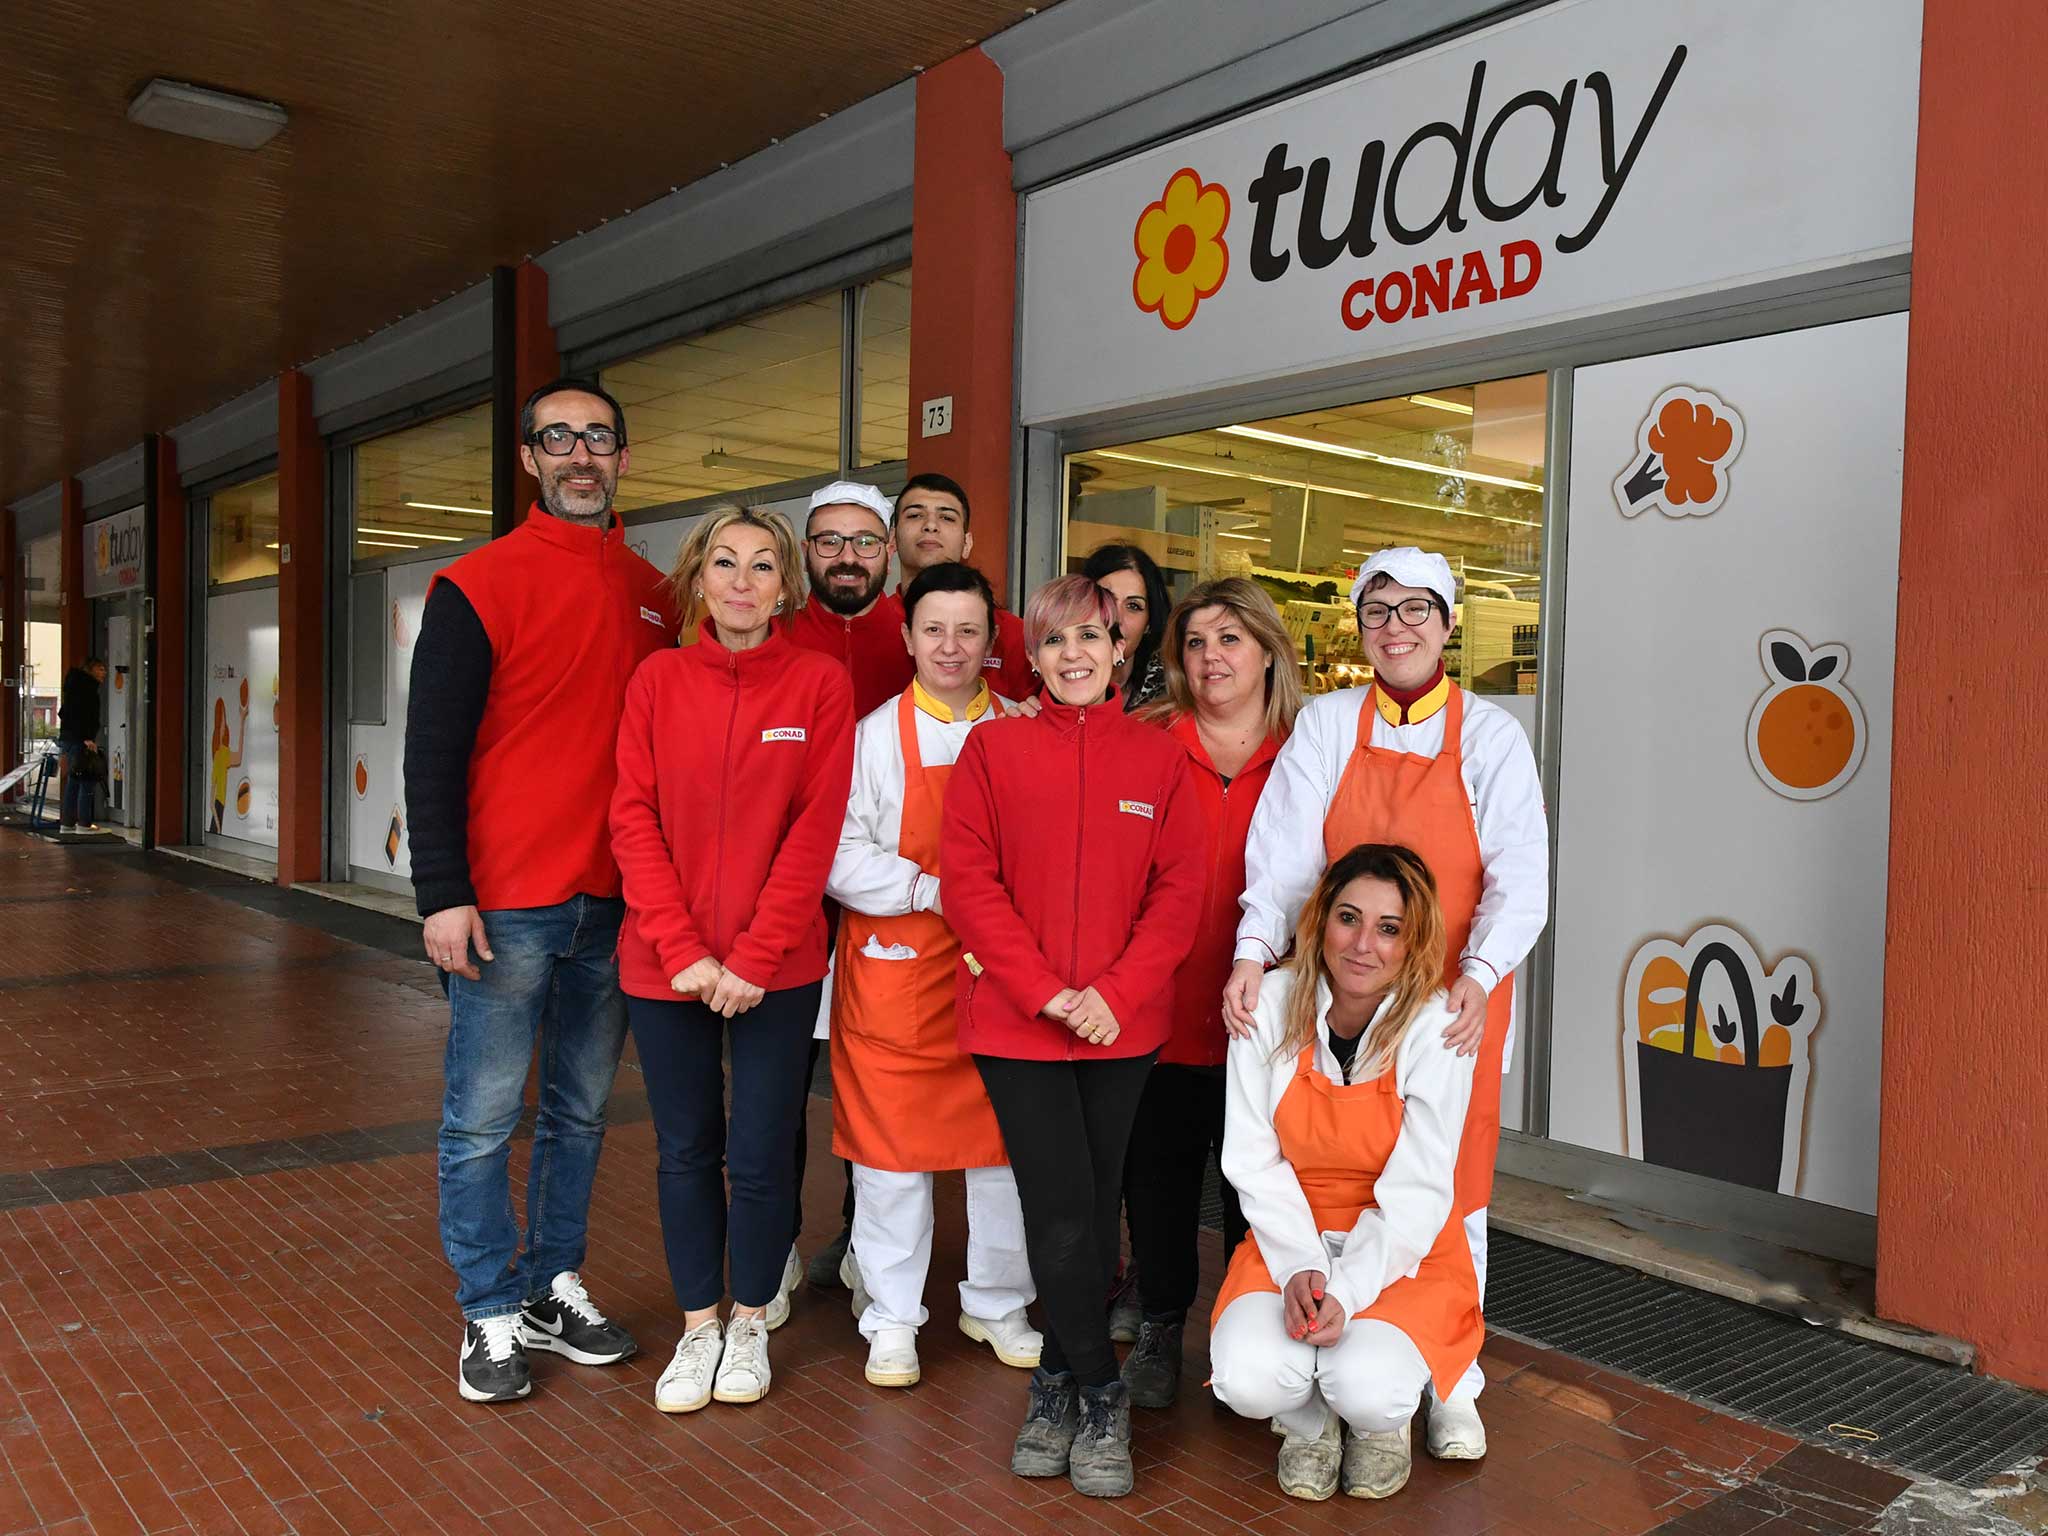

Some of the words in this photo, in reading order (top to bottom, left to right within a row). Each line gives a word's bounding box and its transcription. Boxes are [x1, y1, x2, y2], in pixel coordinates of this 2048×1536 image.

[1248, 44, 1688, 282] tuday
[1341, 239, 1542, 331] CONAD
[929, 405, 945, 428] 73
[772, 730, 803, 738] CONAD
